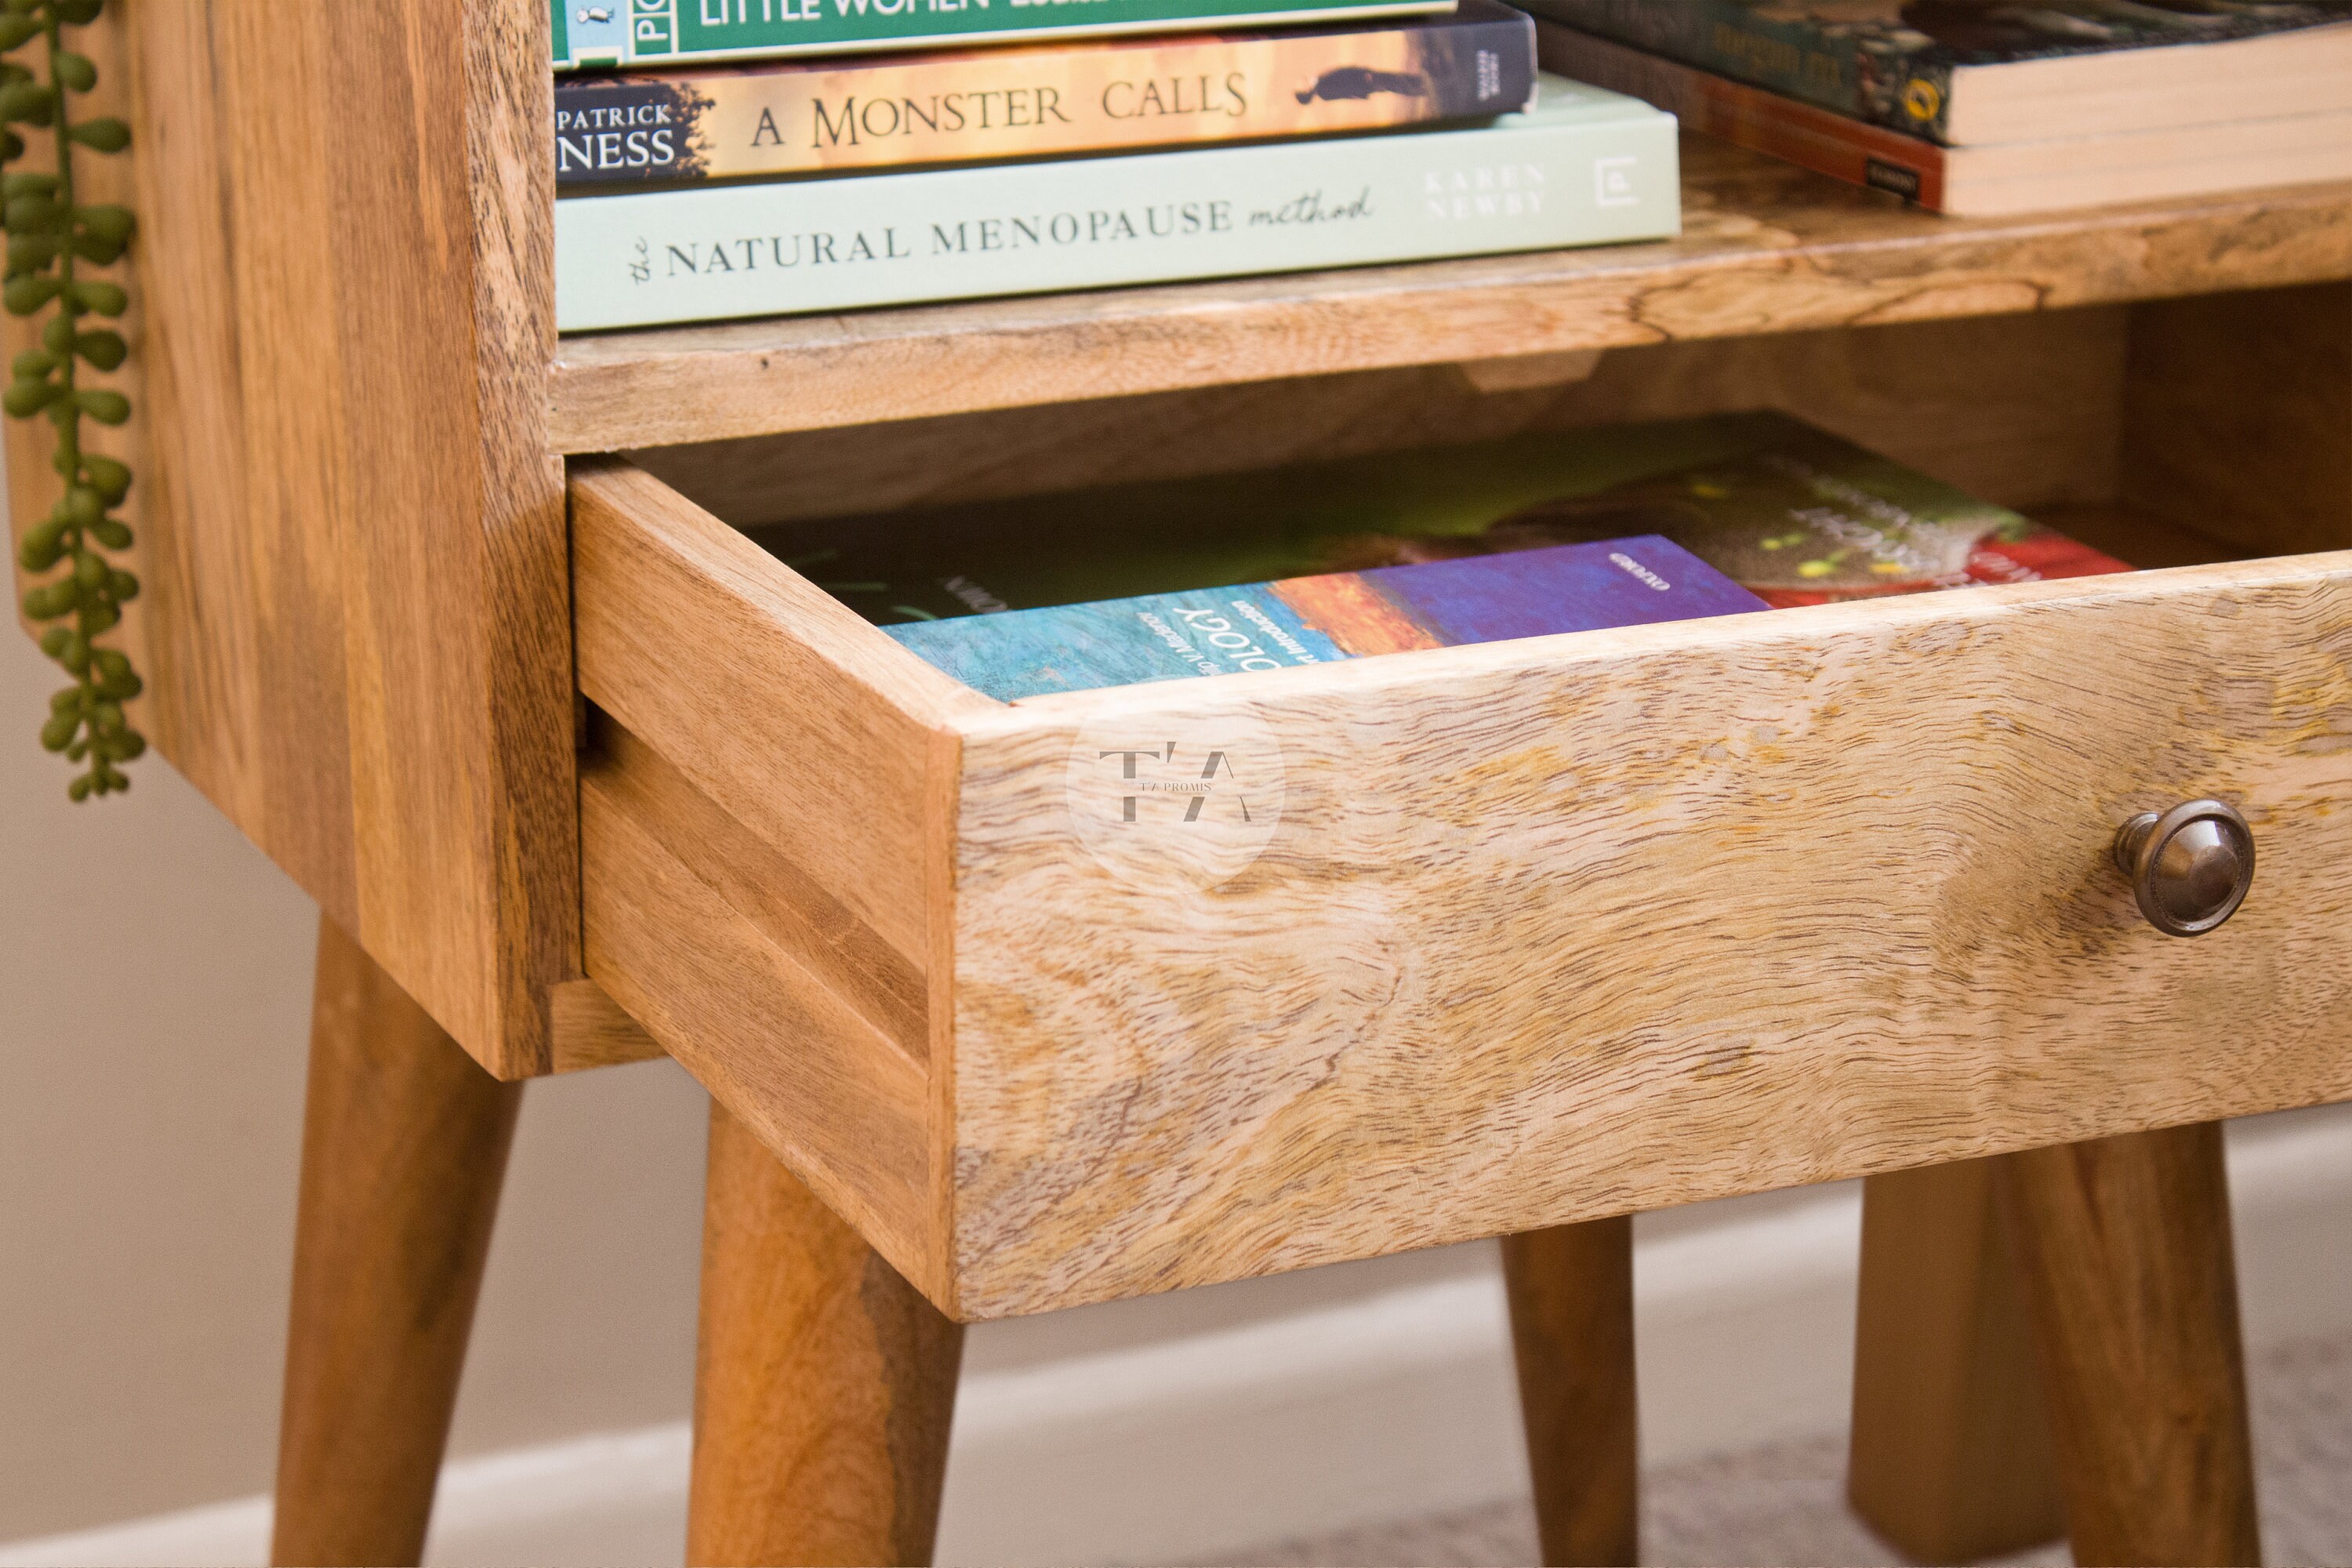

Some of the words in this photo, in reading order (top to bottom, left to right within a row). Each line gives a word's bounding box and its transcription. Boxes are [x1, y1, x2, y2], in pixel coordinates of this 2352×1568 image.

[557, 103, 672, 131] PATRICK
[750, 107, 785, 147] A
[811, 86, 1072, 148] MONSTER
[1102, 72, 1247, 119] CALLS
[557, 129, 675, 172] NESS
[1425, 163, 1544, 194] KAREN
[628, 235, 652, 285] the
[666, 227, 912, 277] NATURAL
[931, 200, 1234, 255] MENOPAUSE
[1248, 185, 1376, 228] method
[1231, 600, 1308, 655] Introduction
